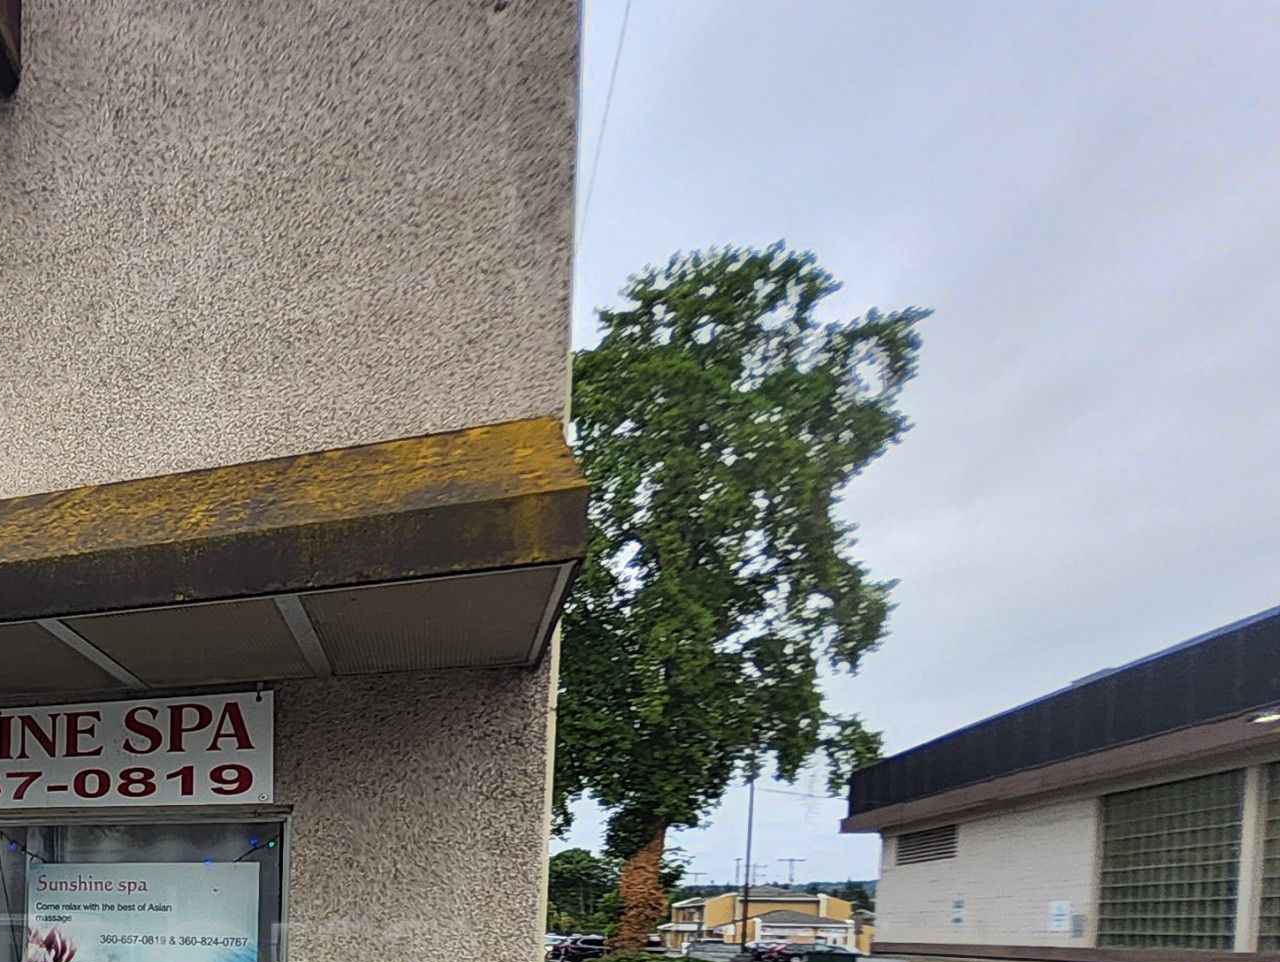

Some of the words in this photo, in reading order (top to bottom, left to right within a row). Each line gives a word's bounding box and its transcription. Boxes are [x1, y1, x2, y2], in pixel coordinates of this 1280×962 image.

[122, 701, 255, 755] SPA
[36, 875, 113, 892] Sunshine
[117, 879, 148, 895] spa
[36, 902, 60, 911] Come
[61, 902, 81, 911] relax
[83, 903, 100, 911] with
[102, 903, 115, 911] the
[117, 903, 135, 912] best
[137, 903, 147, 912] of
[147, 903, 172, 912] Asian
[36, 914, 72, 923] massage
[100, 934, 167, 945] 360-657-0819
[169, 936, 176, 945] &
[179, 936, 248, 947] 360-824-0767
